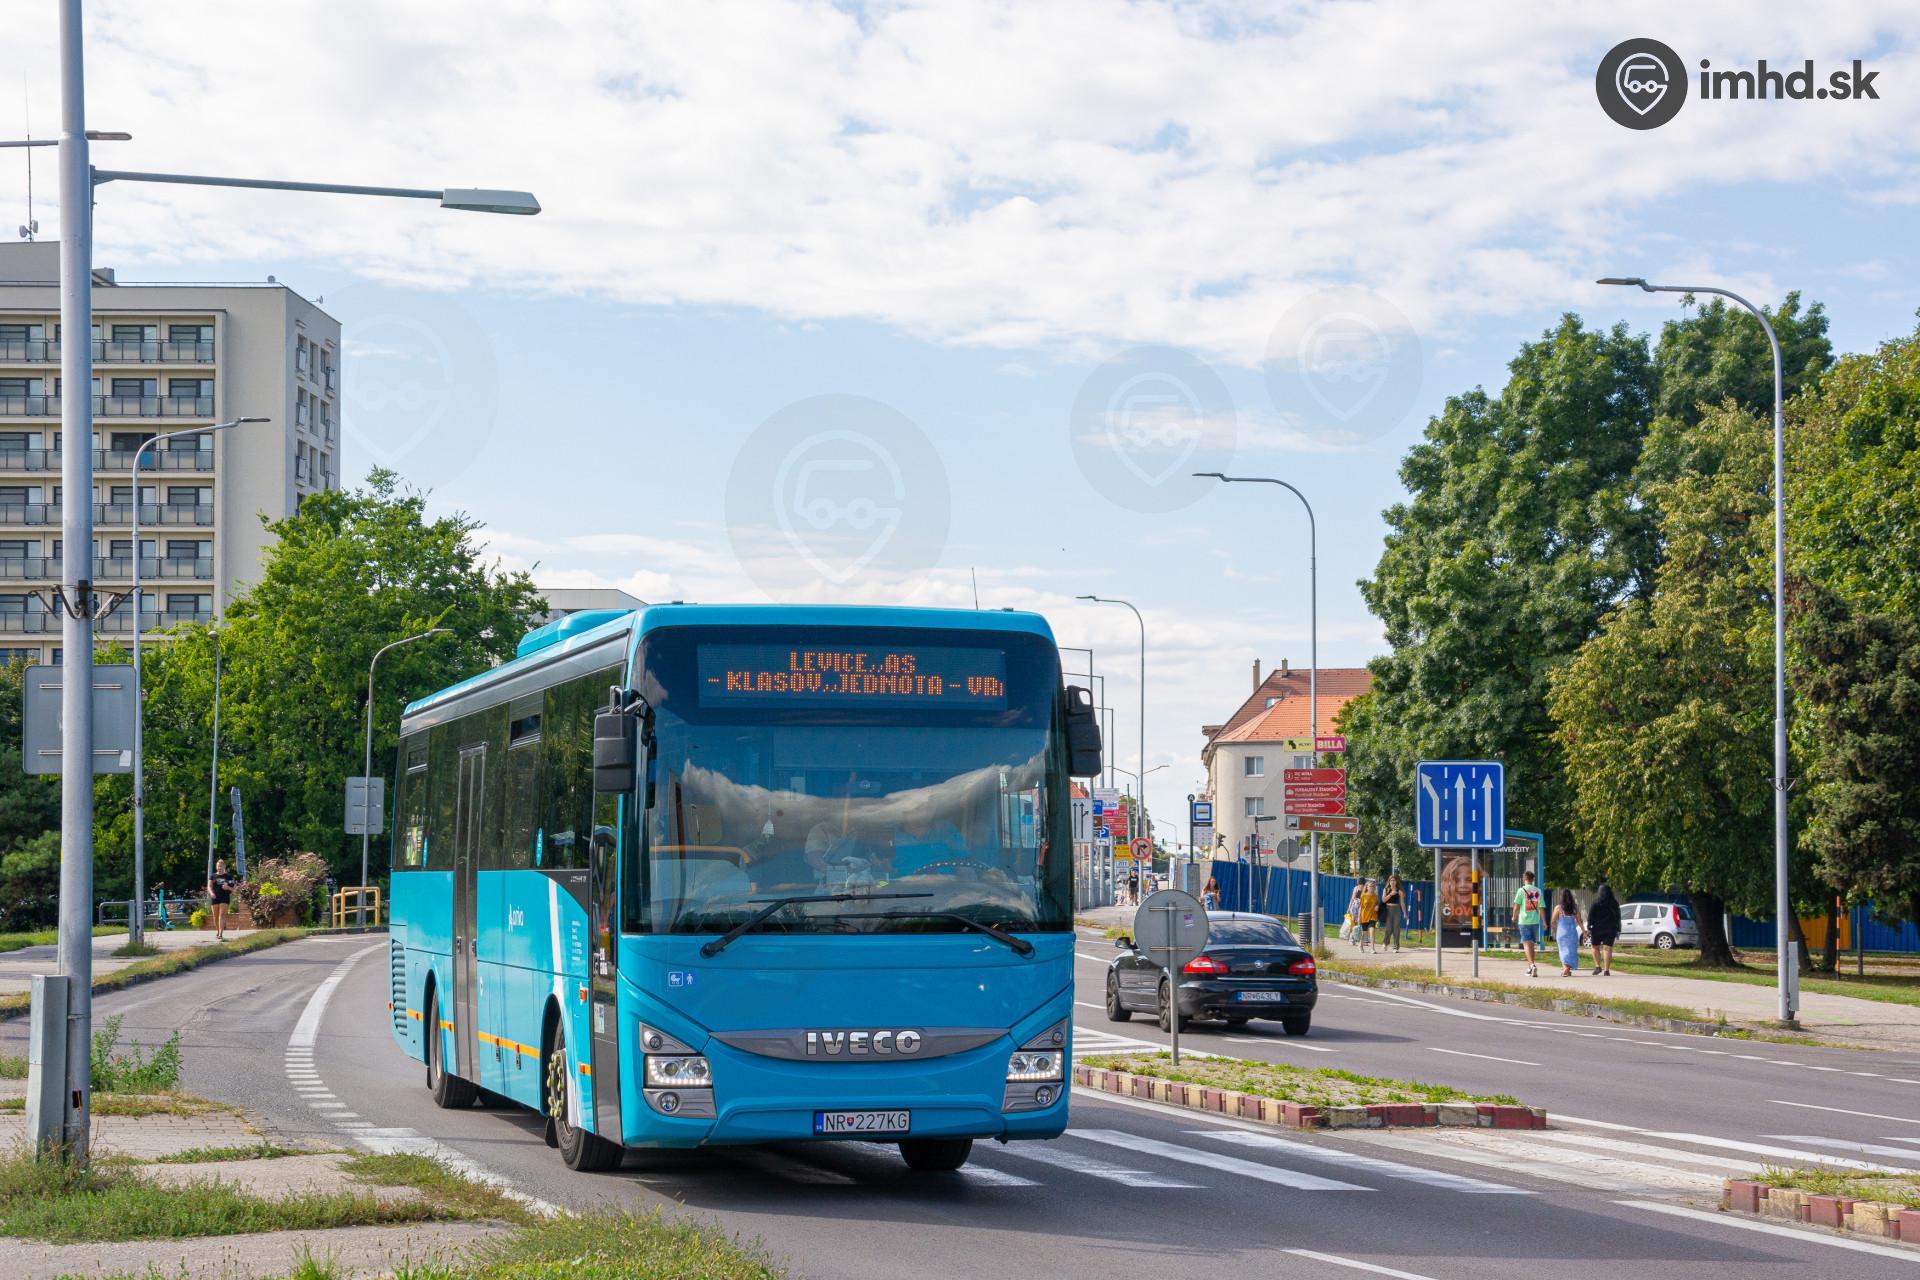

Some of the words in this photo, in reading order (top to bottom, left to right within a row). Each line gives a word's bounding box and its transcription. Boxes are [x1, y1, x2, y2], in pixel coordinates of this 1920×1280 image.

[967, 676, 1004, 696] VR
[1316, 739, 1344, 750] BILLA
[1313, 820, 1331, 829] Hrad
[807, 1030, 921, 1055] IVECO
